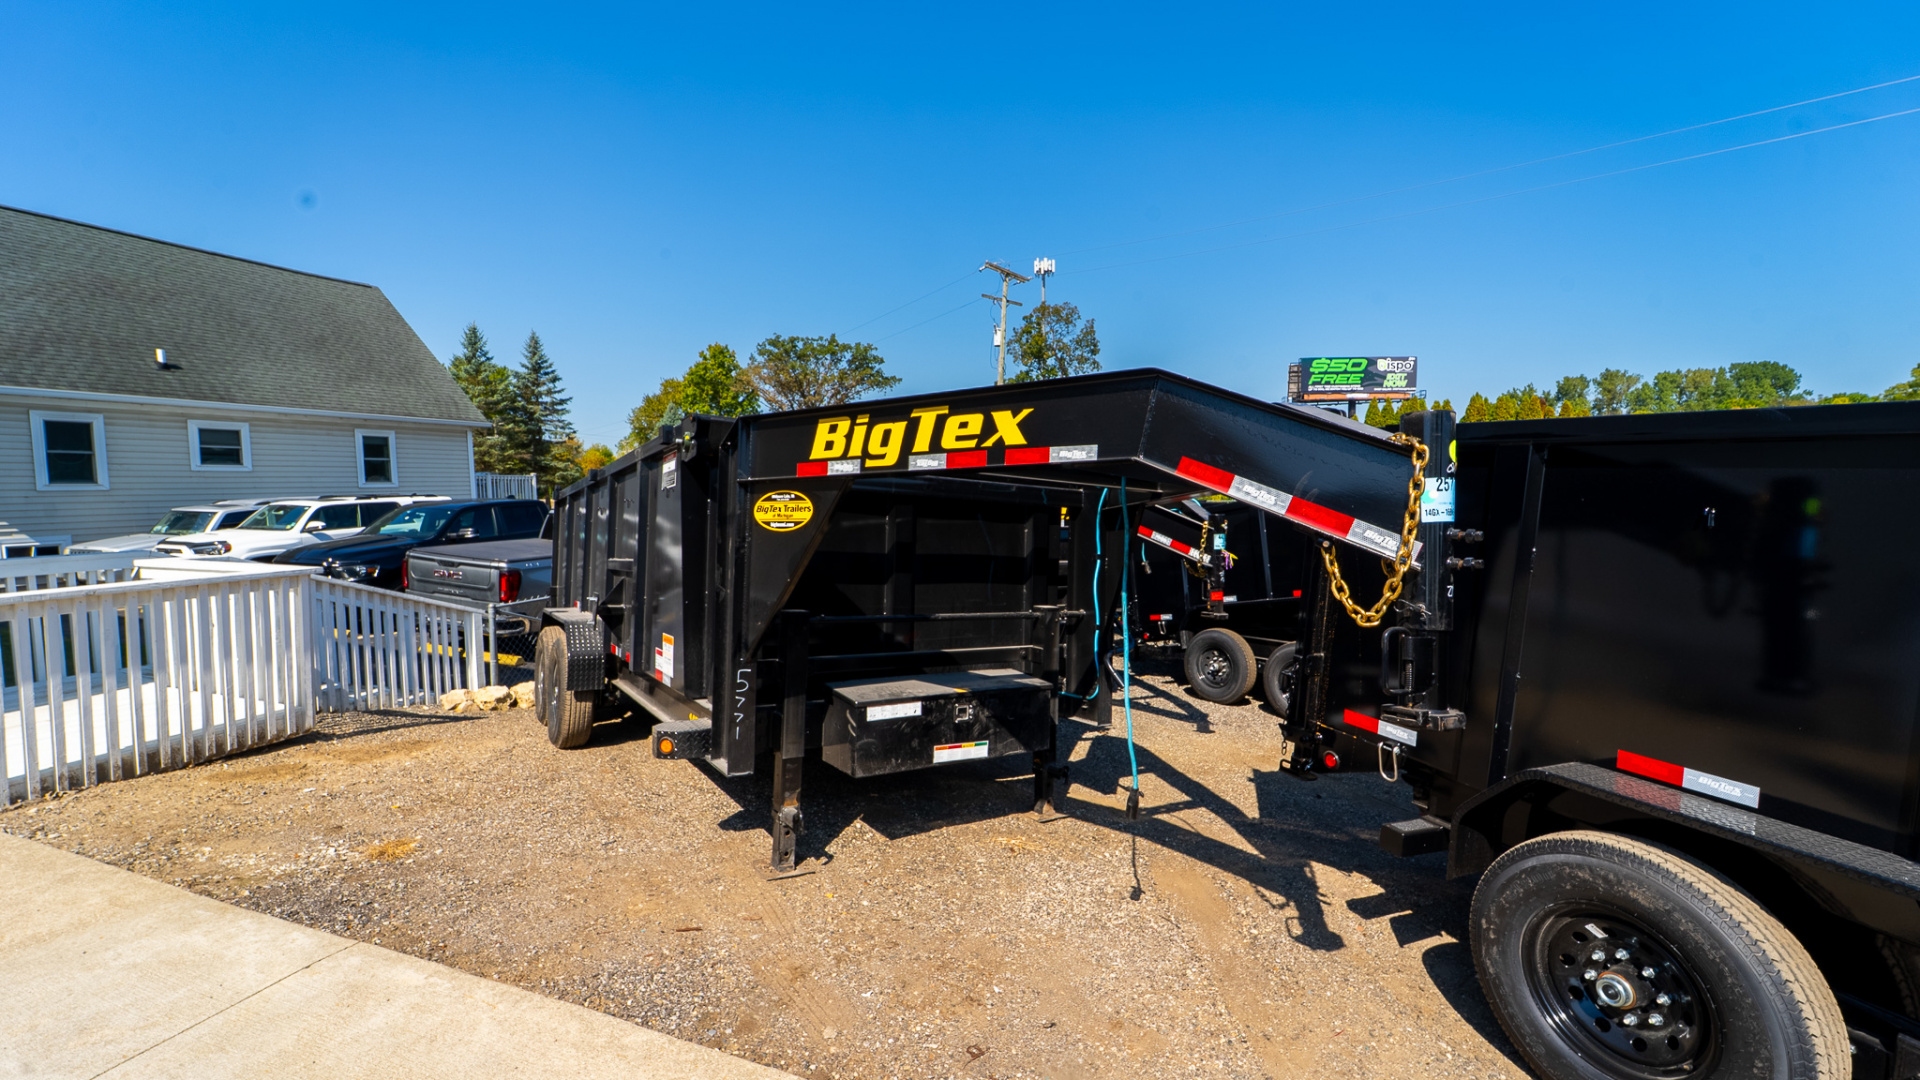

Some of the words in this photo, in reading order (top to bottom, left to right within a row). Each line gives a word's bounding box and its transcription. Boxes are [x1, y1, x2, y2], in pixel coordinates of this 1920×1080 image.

[1309, 357, 1368, 374] $50
[1308, 373, 1364, 385] FREE
[809, 405, 1034, 468] BigTex
[756, 504, 782, 515] BigTex
[783, 504, 812, 513] Trailers
[433, 568, 463, 580] GMC
[1698, 775, 1743, 797] BigTex
